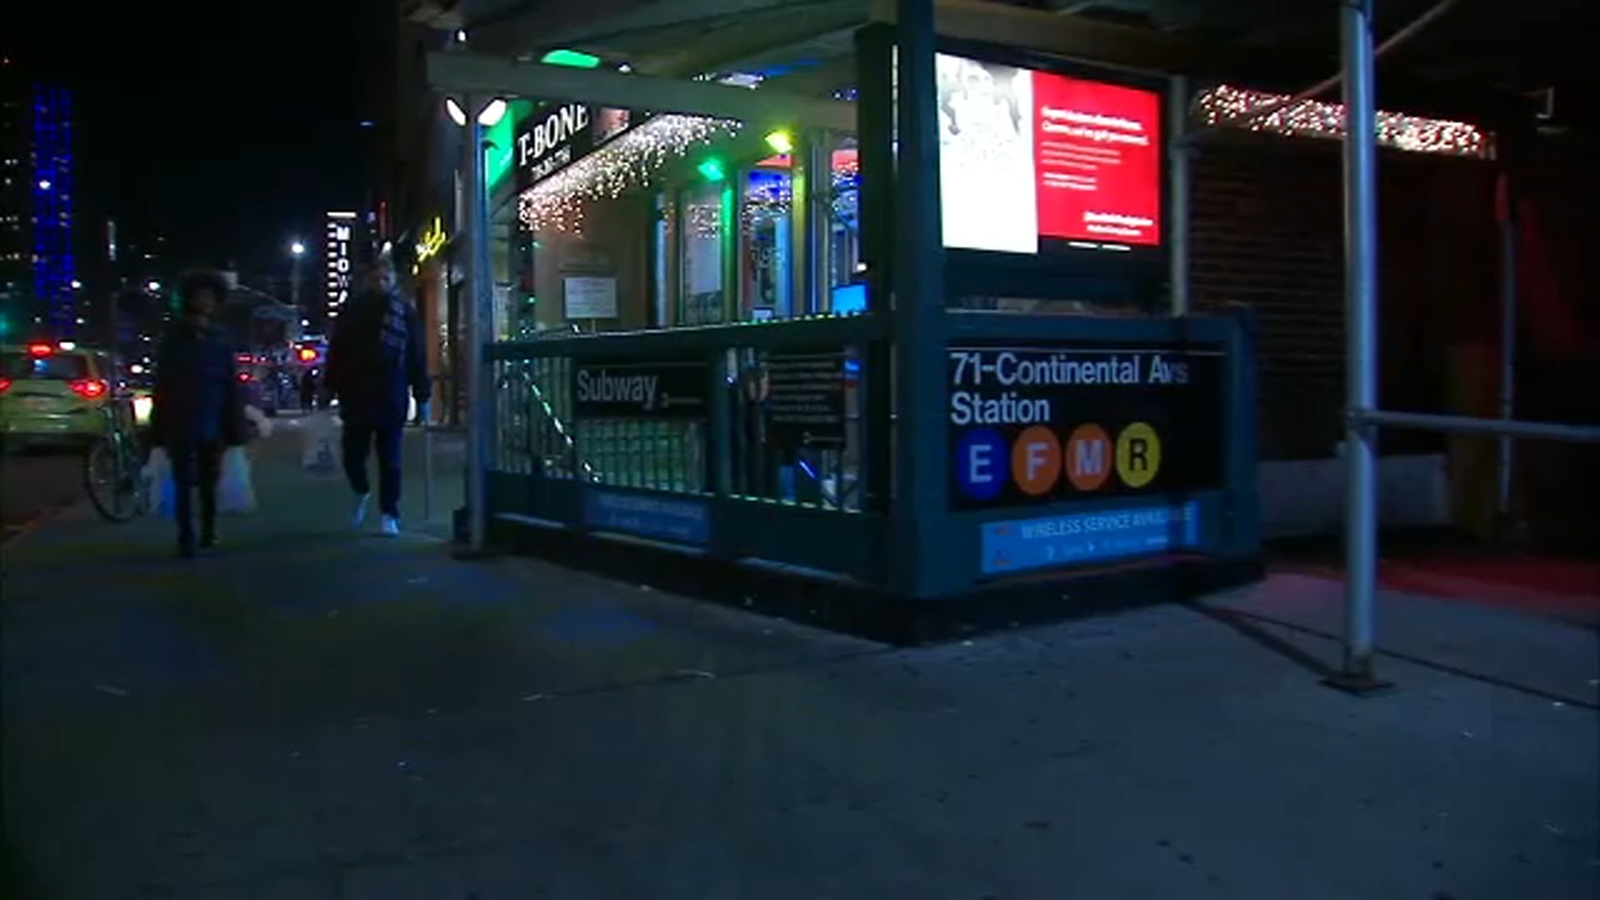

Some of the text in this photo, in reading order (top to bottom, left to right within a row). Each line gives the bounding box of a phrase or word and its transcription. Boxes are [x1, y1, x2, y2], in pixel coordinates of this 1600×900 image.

[518, 104, 588, 166] T-BONE
[950, 351, 1189, 385] 71-Continental Avs
[577, 369, 657, 410] Subway
[950, 391, 1050, 424] Station
[969, 437, 1149, 483] E F M R
[1021, 518, 1081, 539] WIRELESS
[1083, 513, 1131, 533] SERVICE
